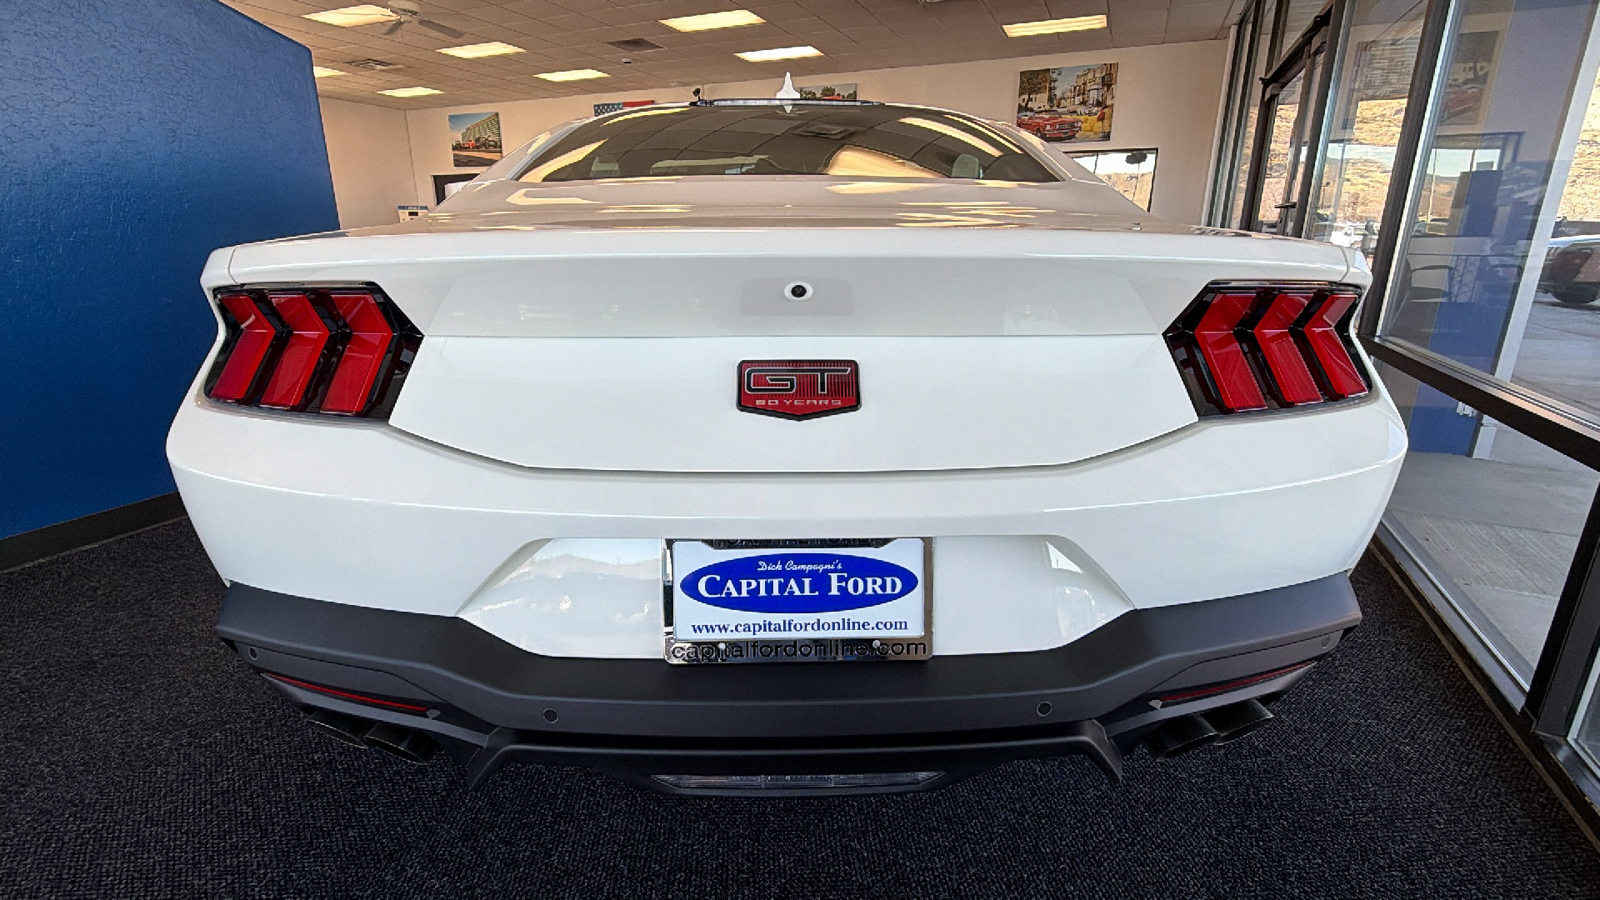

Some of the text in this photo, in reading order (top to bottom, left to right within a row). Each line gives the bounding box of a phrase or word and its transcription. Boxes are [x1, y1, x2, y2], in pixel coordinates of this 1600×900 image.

[745, 366, 851, 394] GT
[757, 559, 842, 573] Dick Campagni's
[697, 572, 902, 597] CAPITAL FORD
[691, 618, 908, 635] www.capitalfordonline.com
[673, 640, 927, 662] capitalfordonline.com
